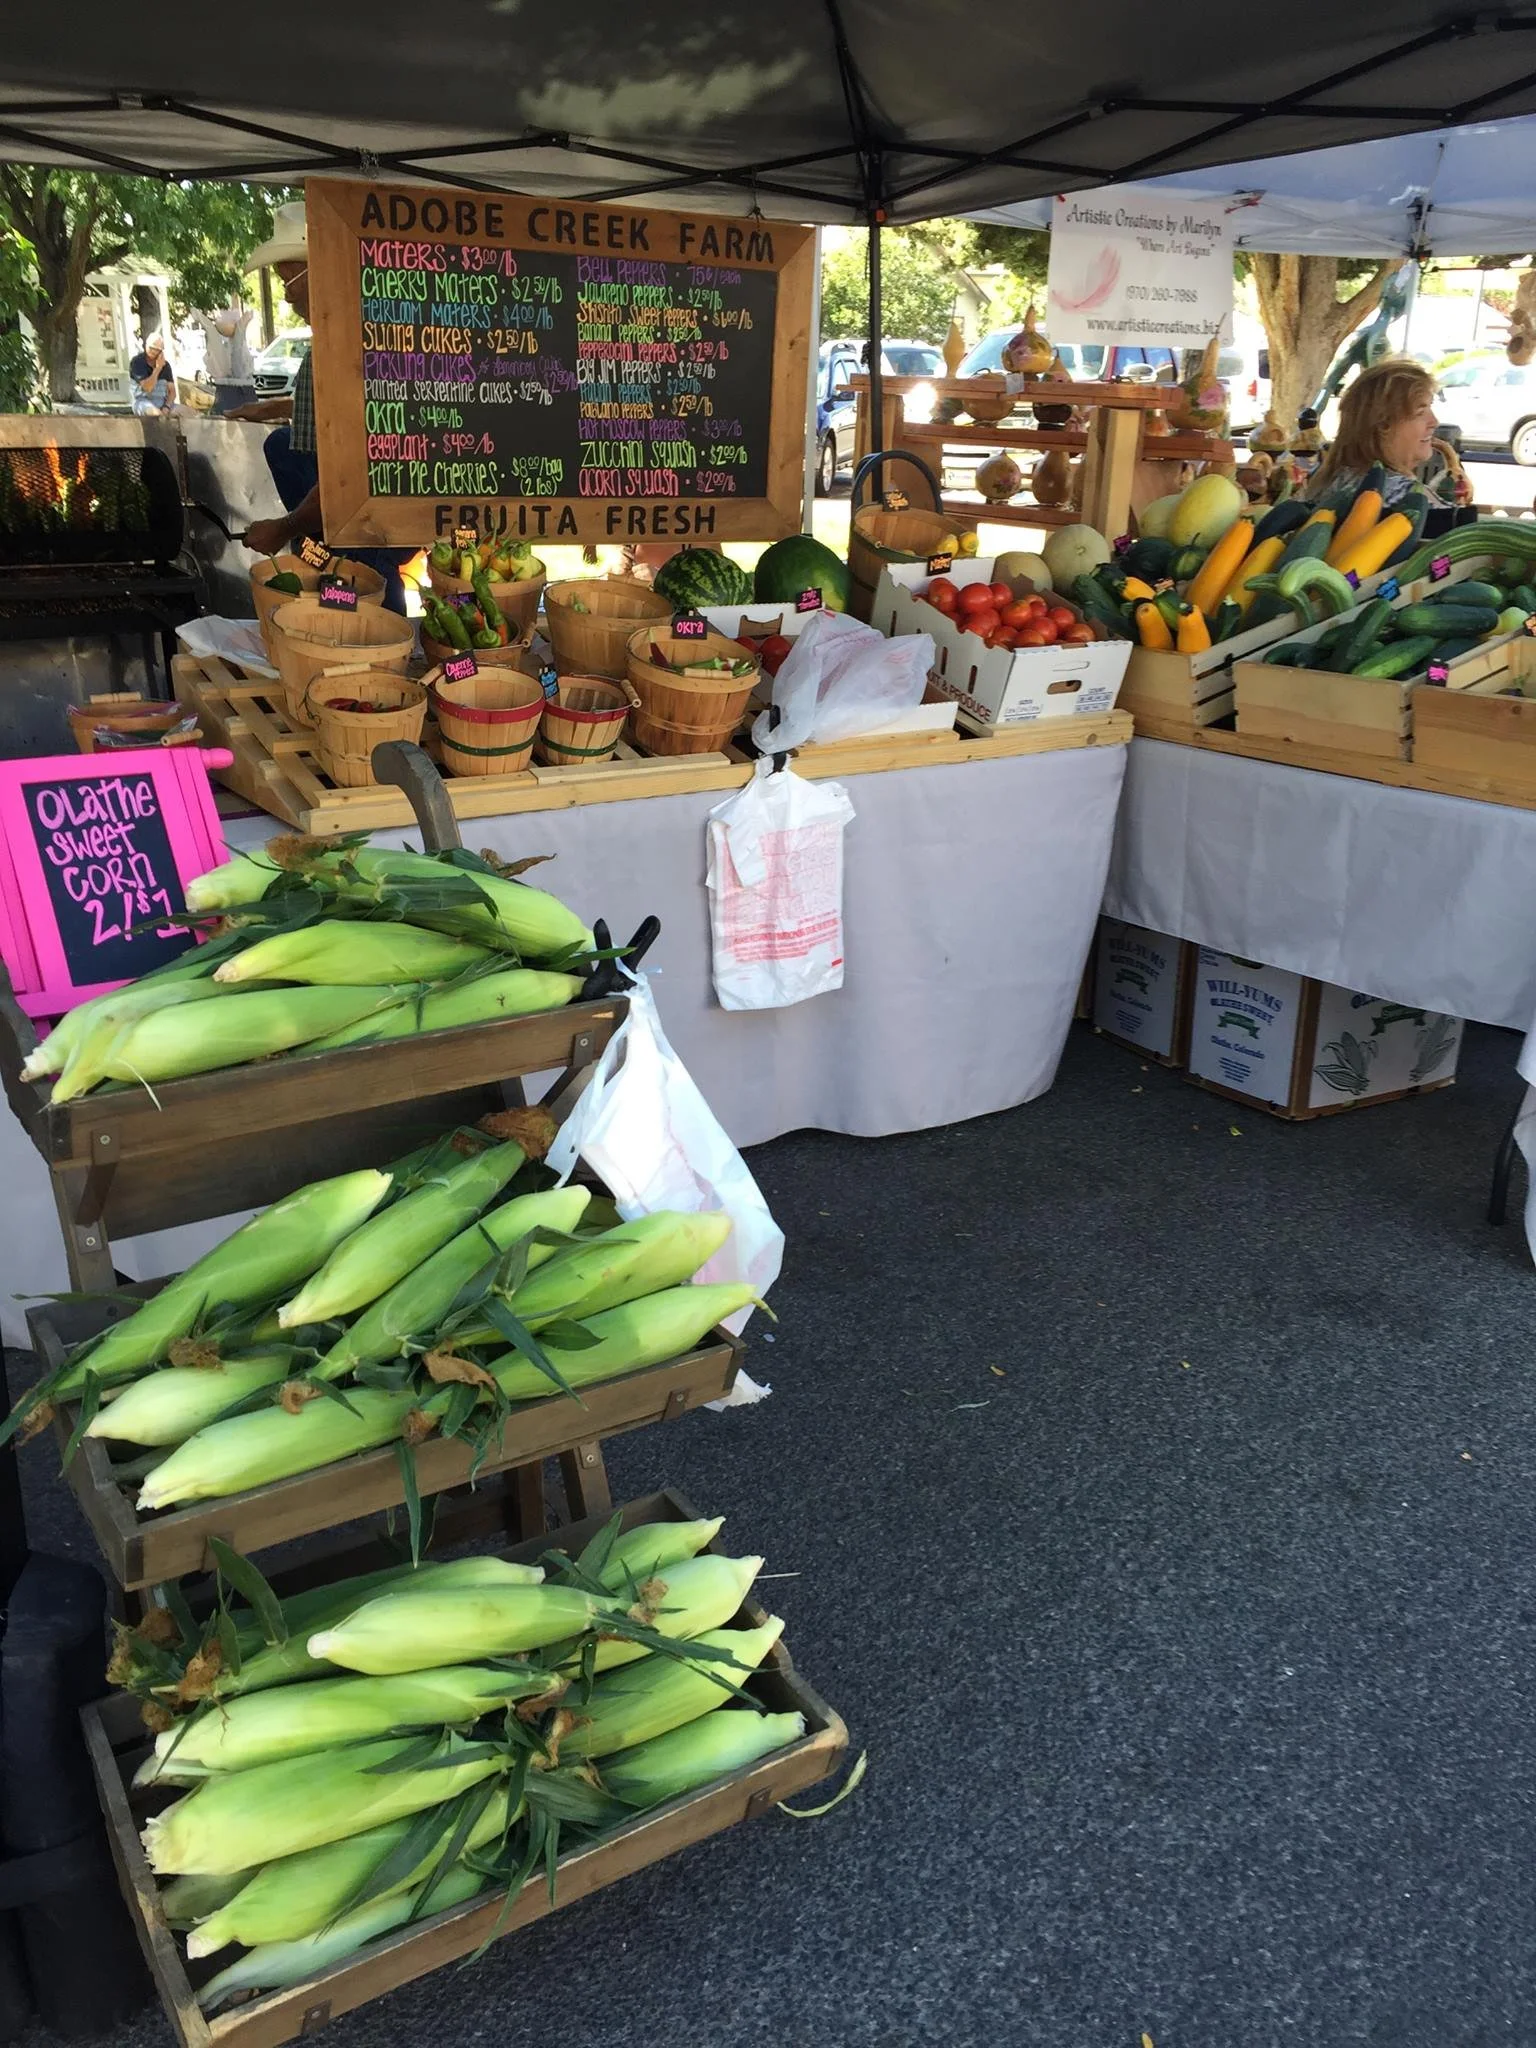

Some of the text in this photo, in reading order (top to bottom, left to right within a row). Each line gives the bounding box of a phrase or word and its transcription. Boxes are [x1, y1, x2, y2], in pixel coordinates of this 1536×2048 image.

[361, 192, 774, 264] ADOBE CREEK FARM
[1066, 204, 1222, 240] Artistic Creations by Marilyn
[435, 505, 716, 537] FRUITA FRESH
[949, 684, 993, 722] PRODUCE
[1206, 979, 1283, 1013] WILL-YUMS
